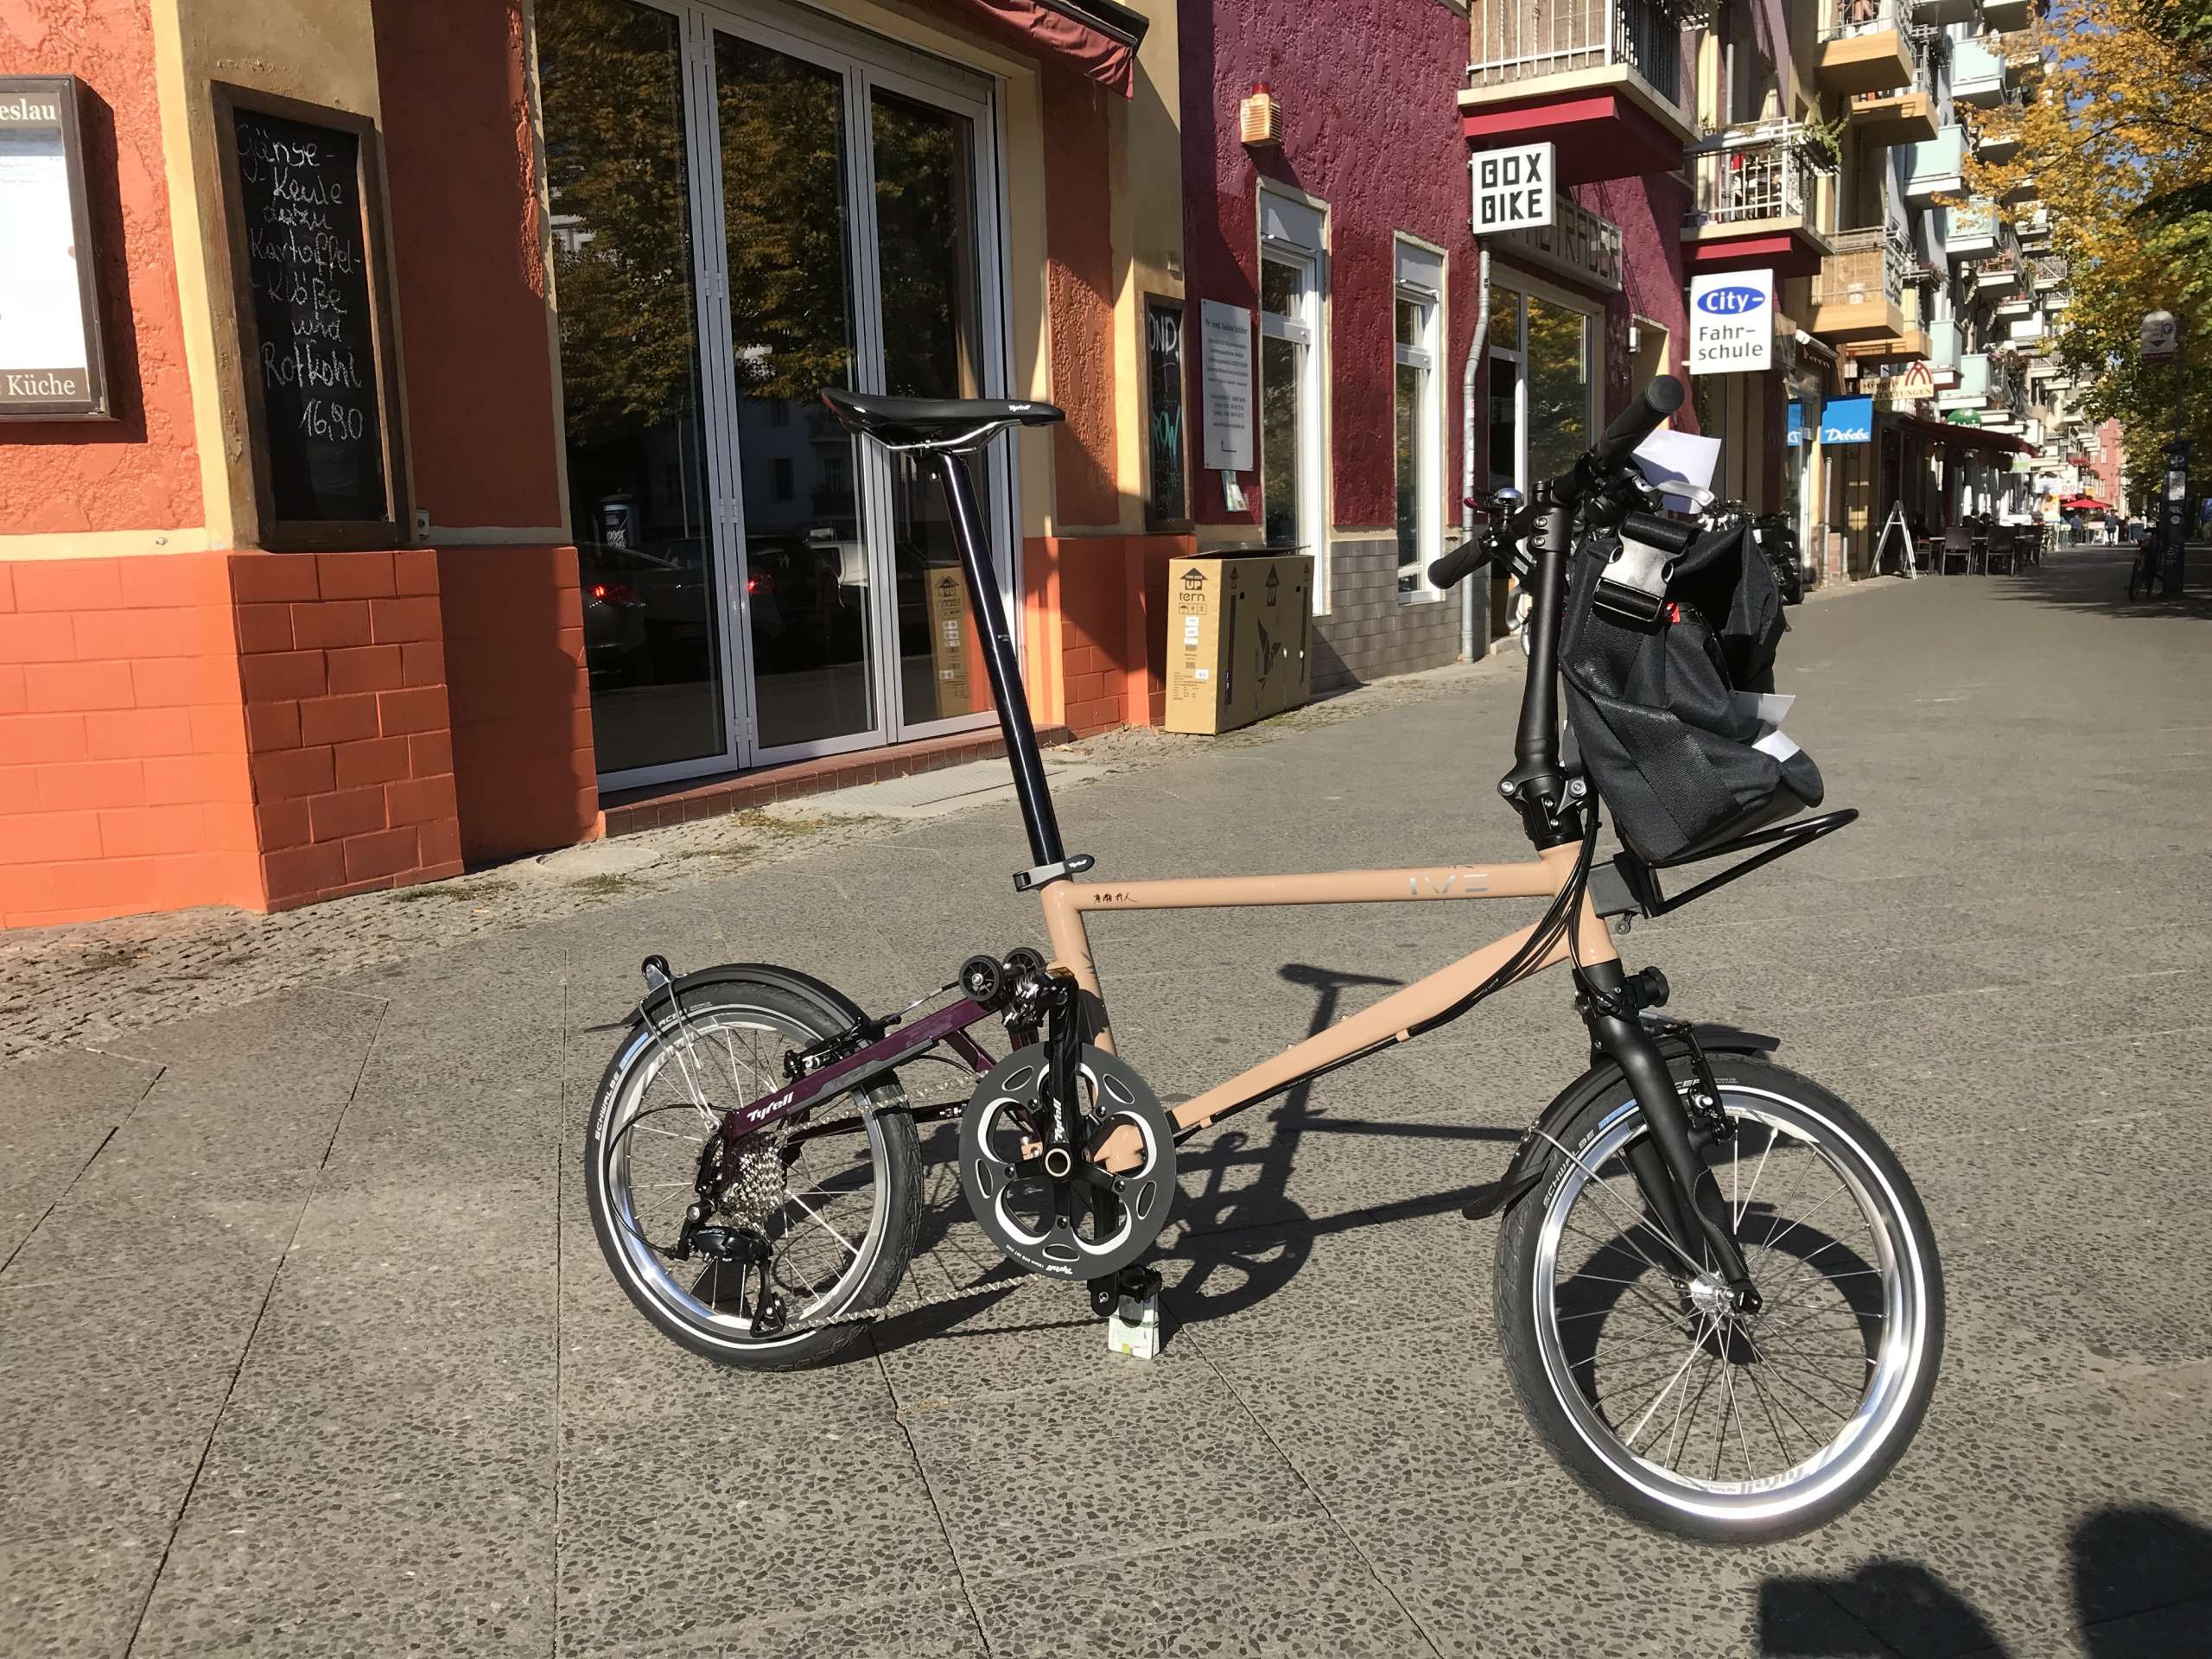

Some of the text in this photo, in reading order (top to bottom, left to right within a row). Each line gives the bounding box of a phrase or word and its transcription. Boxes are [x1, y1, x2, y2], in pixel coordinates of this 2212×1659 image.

[1481, 152, 1542, 189] BOX
[1481, 188, 1543, 225] BIKE
[1706, 290, 1764, 313] City-
[1699, 324, 1756, 342] Fahr-
[1698, 341, 1764, 360] schule
[6, 372, 76, 396] Küche
[1824, 428, 1870, 442] Debeka
[1179, 591, 1206, 602] tern
[1186, 580, 1202, 590] UP
[594, 1071, 620, 1141] SCHWALBE
[746, 1091, 795, 1122] Tyrell
